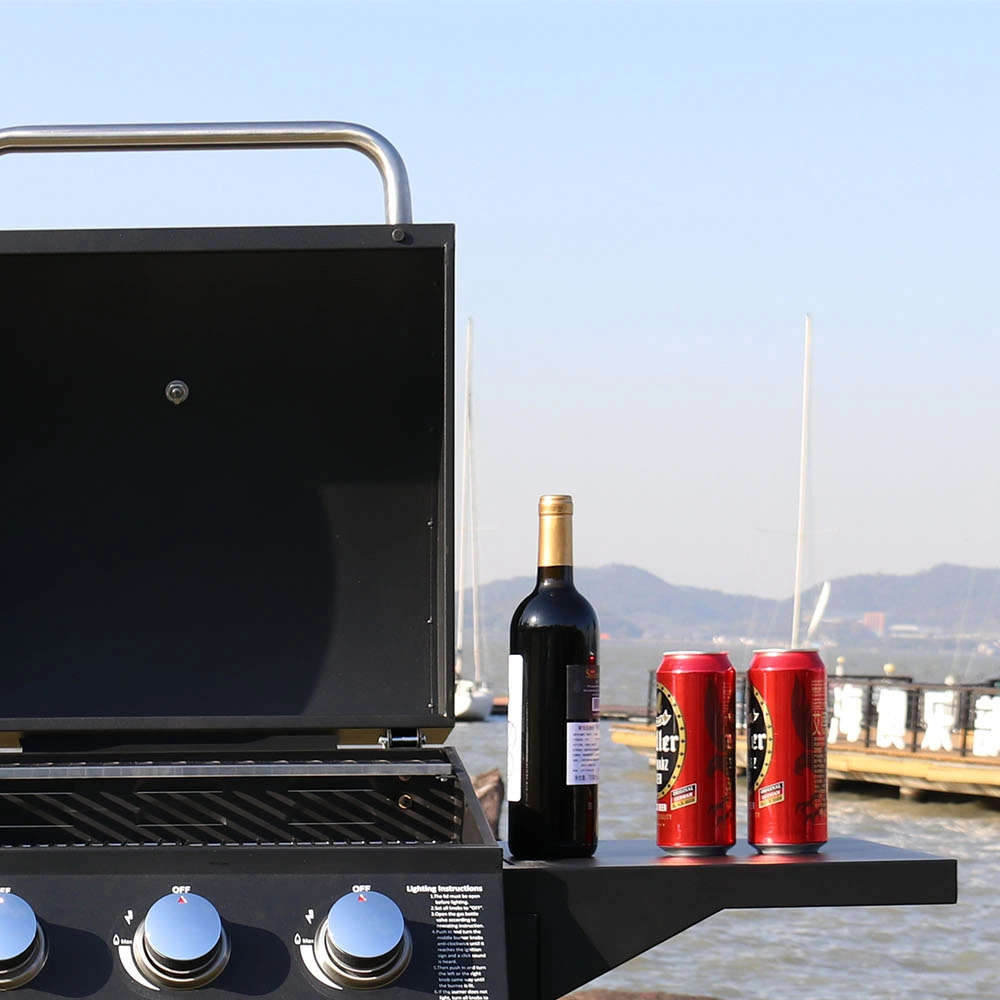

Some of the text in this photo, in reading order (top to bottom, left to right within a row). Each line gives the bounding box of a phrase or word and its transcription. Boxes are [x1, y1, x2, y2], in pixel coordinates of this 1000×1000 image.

[171, 885, 191, 894] OFF
[352, 884, 371, 893] OFF
[406, 885, 437, 894] Lighting
